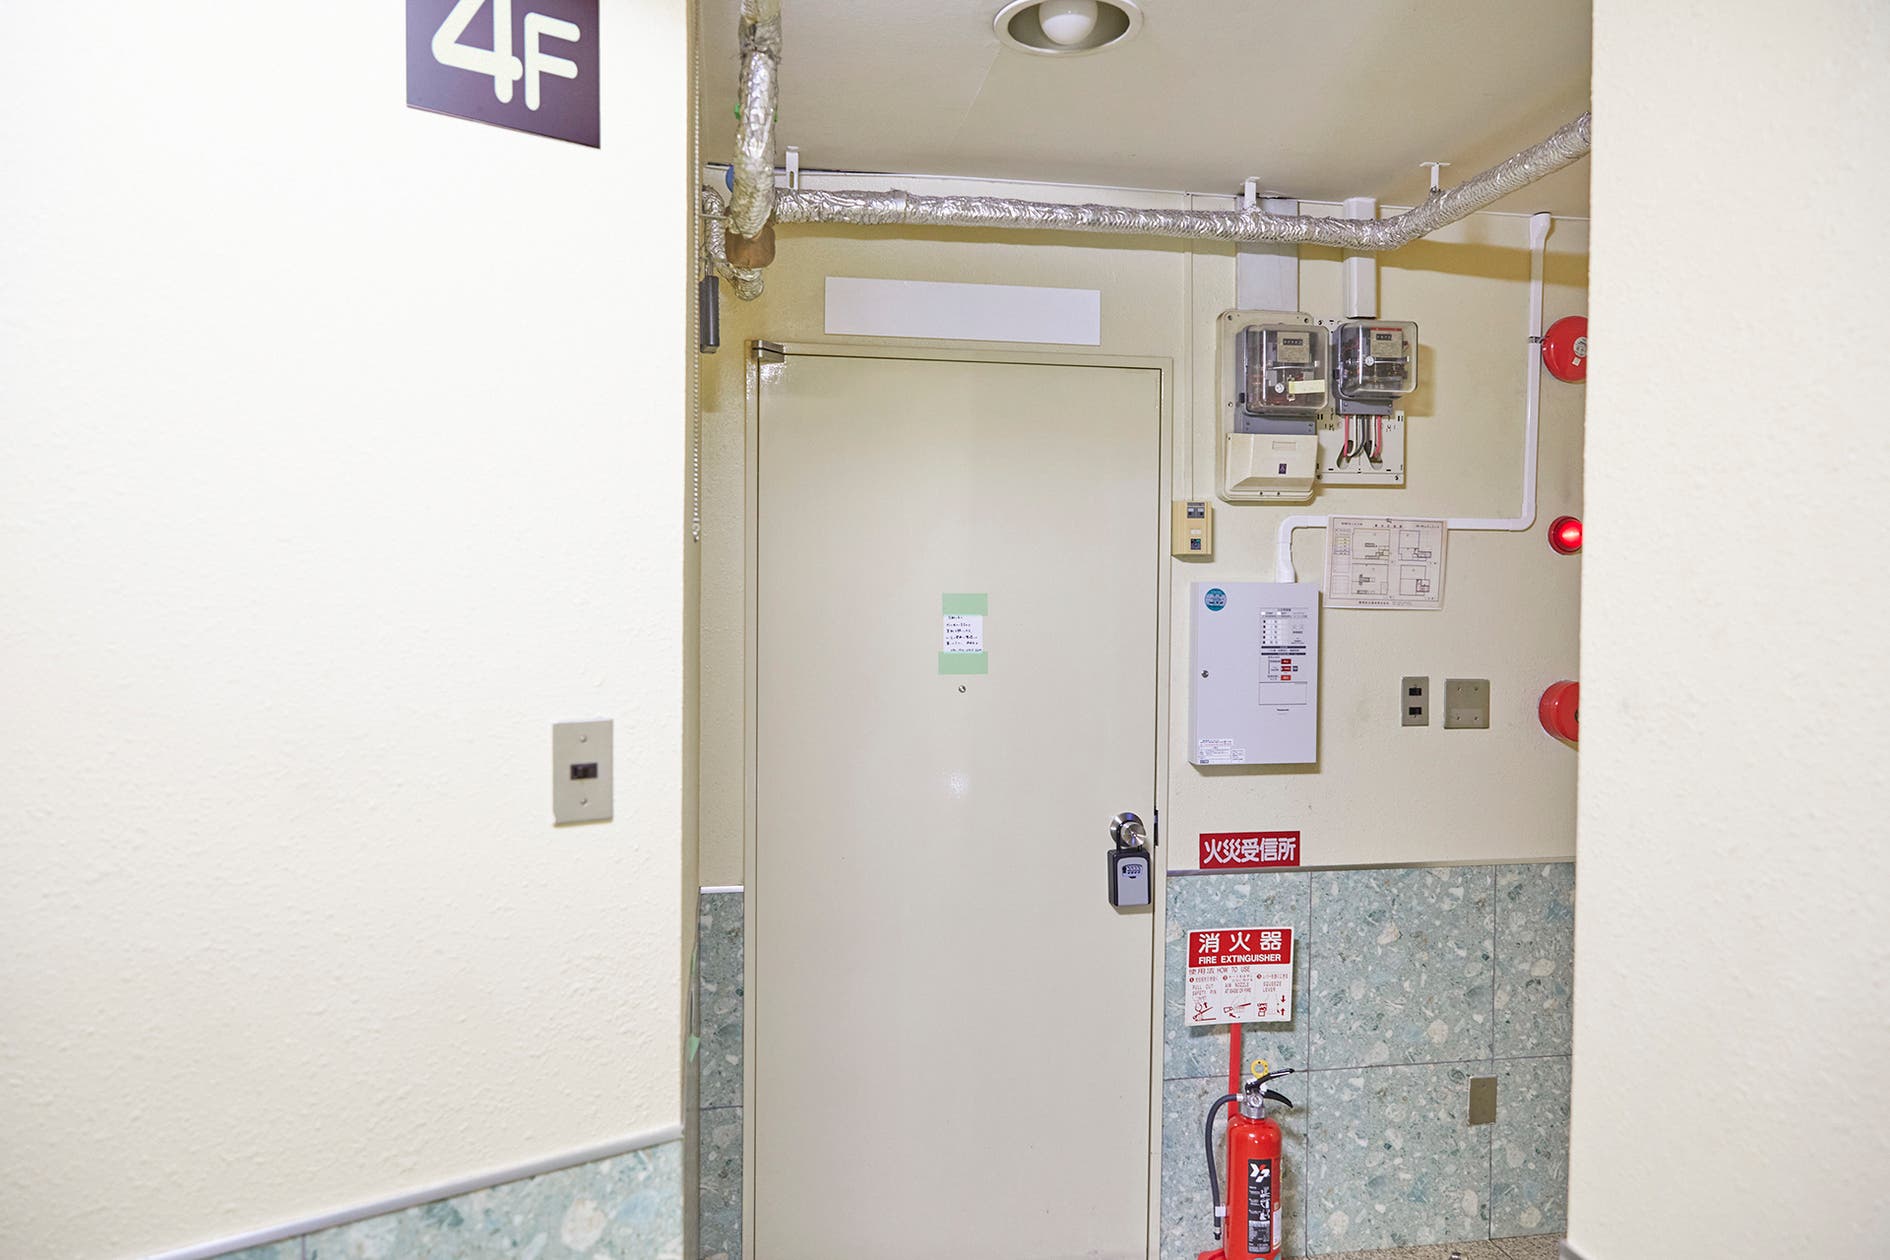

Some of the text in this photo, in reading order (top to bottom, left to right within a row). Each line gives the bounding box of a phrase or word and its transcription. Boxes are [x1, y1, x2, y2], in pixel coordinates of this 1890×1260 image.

[431, 0, 581, 111] 4F
[1203, 837, 1297, 864] 火災受信所
[1198, 931, 1282, 954] 消火器
[1198, 953, 1282, 965] FIRE EXTINGUISHER
